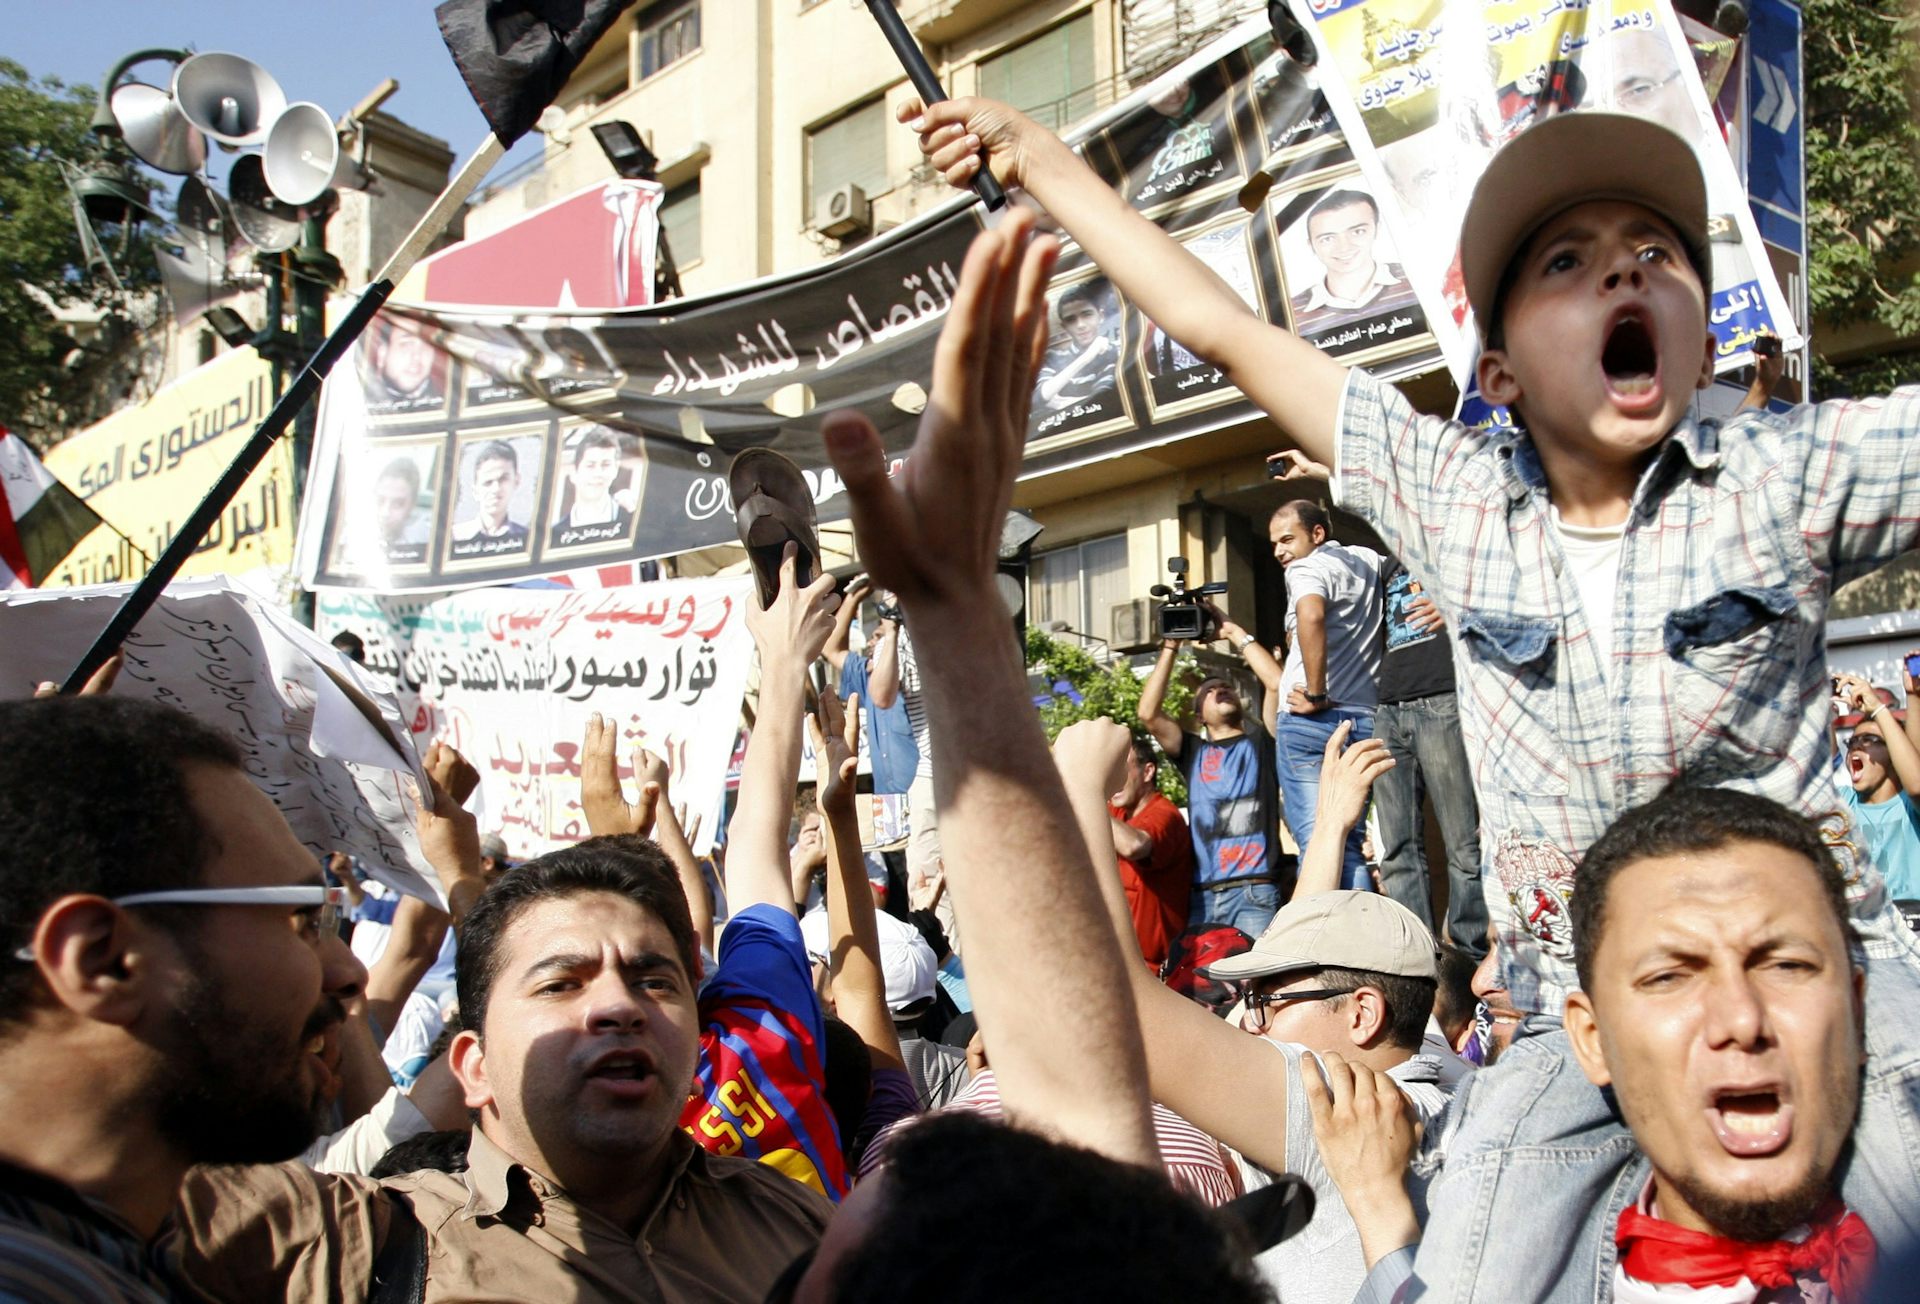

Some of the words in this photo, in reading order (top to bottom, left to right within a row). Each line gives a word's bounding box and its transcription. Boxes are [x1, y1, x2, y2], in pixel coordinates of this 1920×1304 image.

[651, 319, 799, 397] للشهداء
[816, 261, 960, 371] القصاص
[131, 375, 263, 481] الدستورى
[60, 535, 132, 586] المنتخ
[143, 477, 280, 575] البرلان
[686, 1068, 777, 1156] SSI
